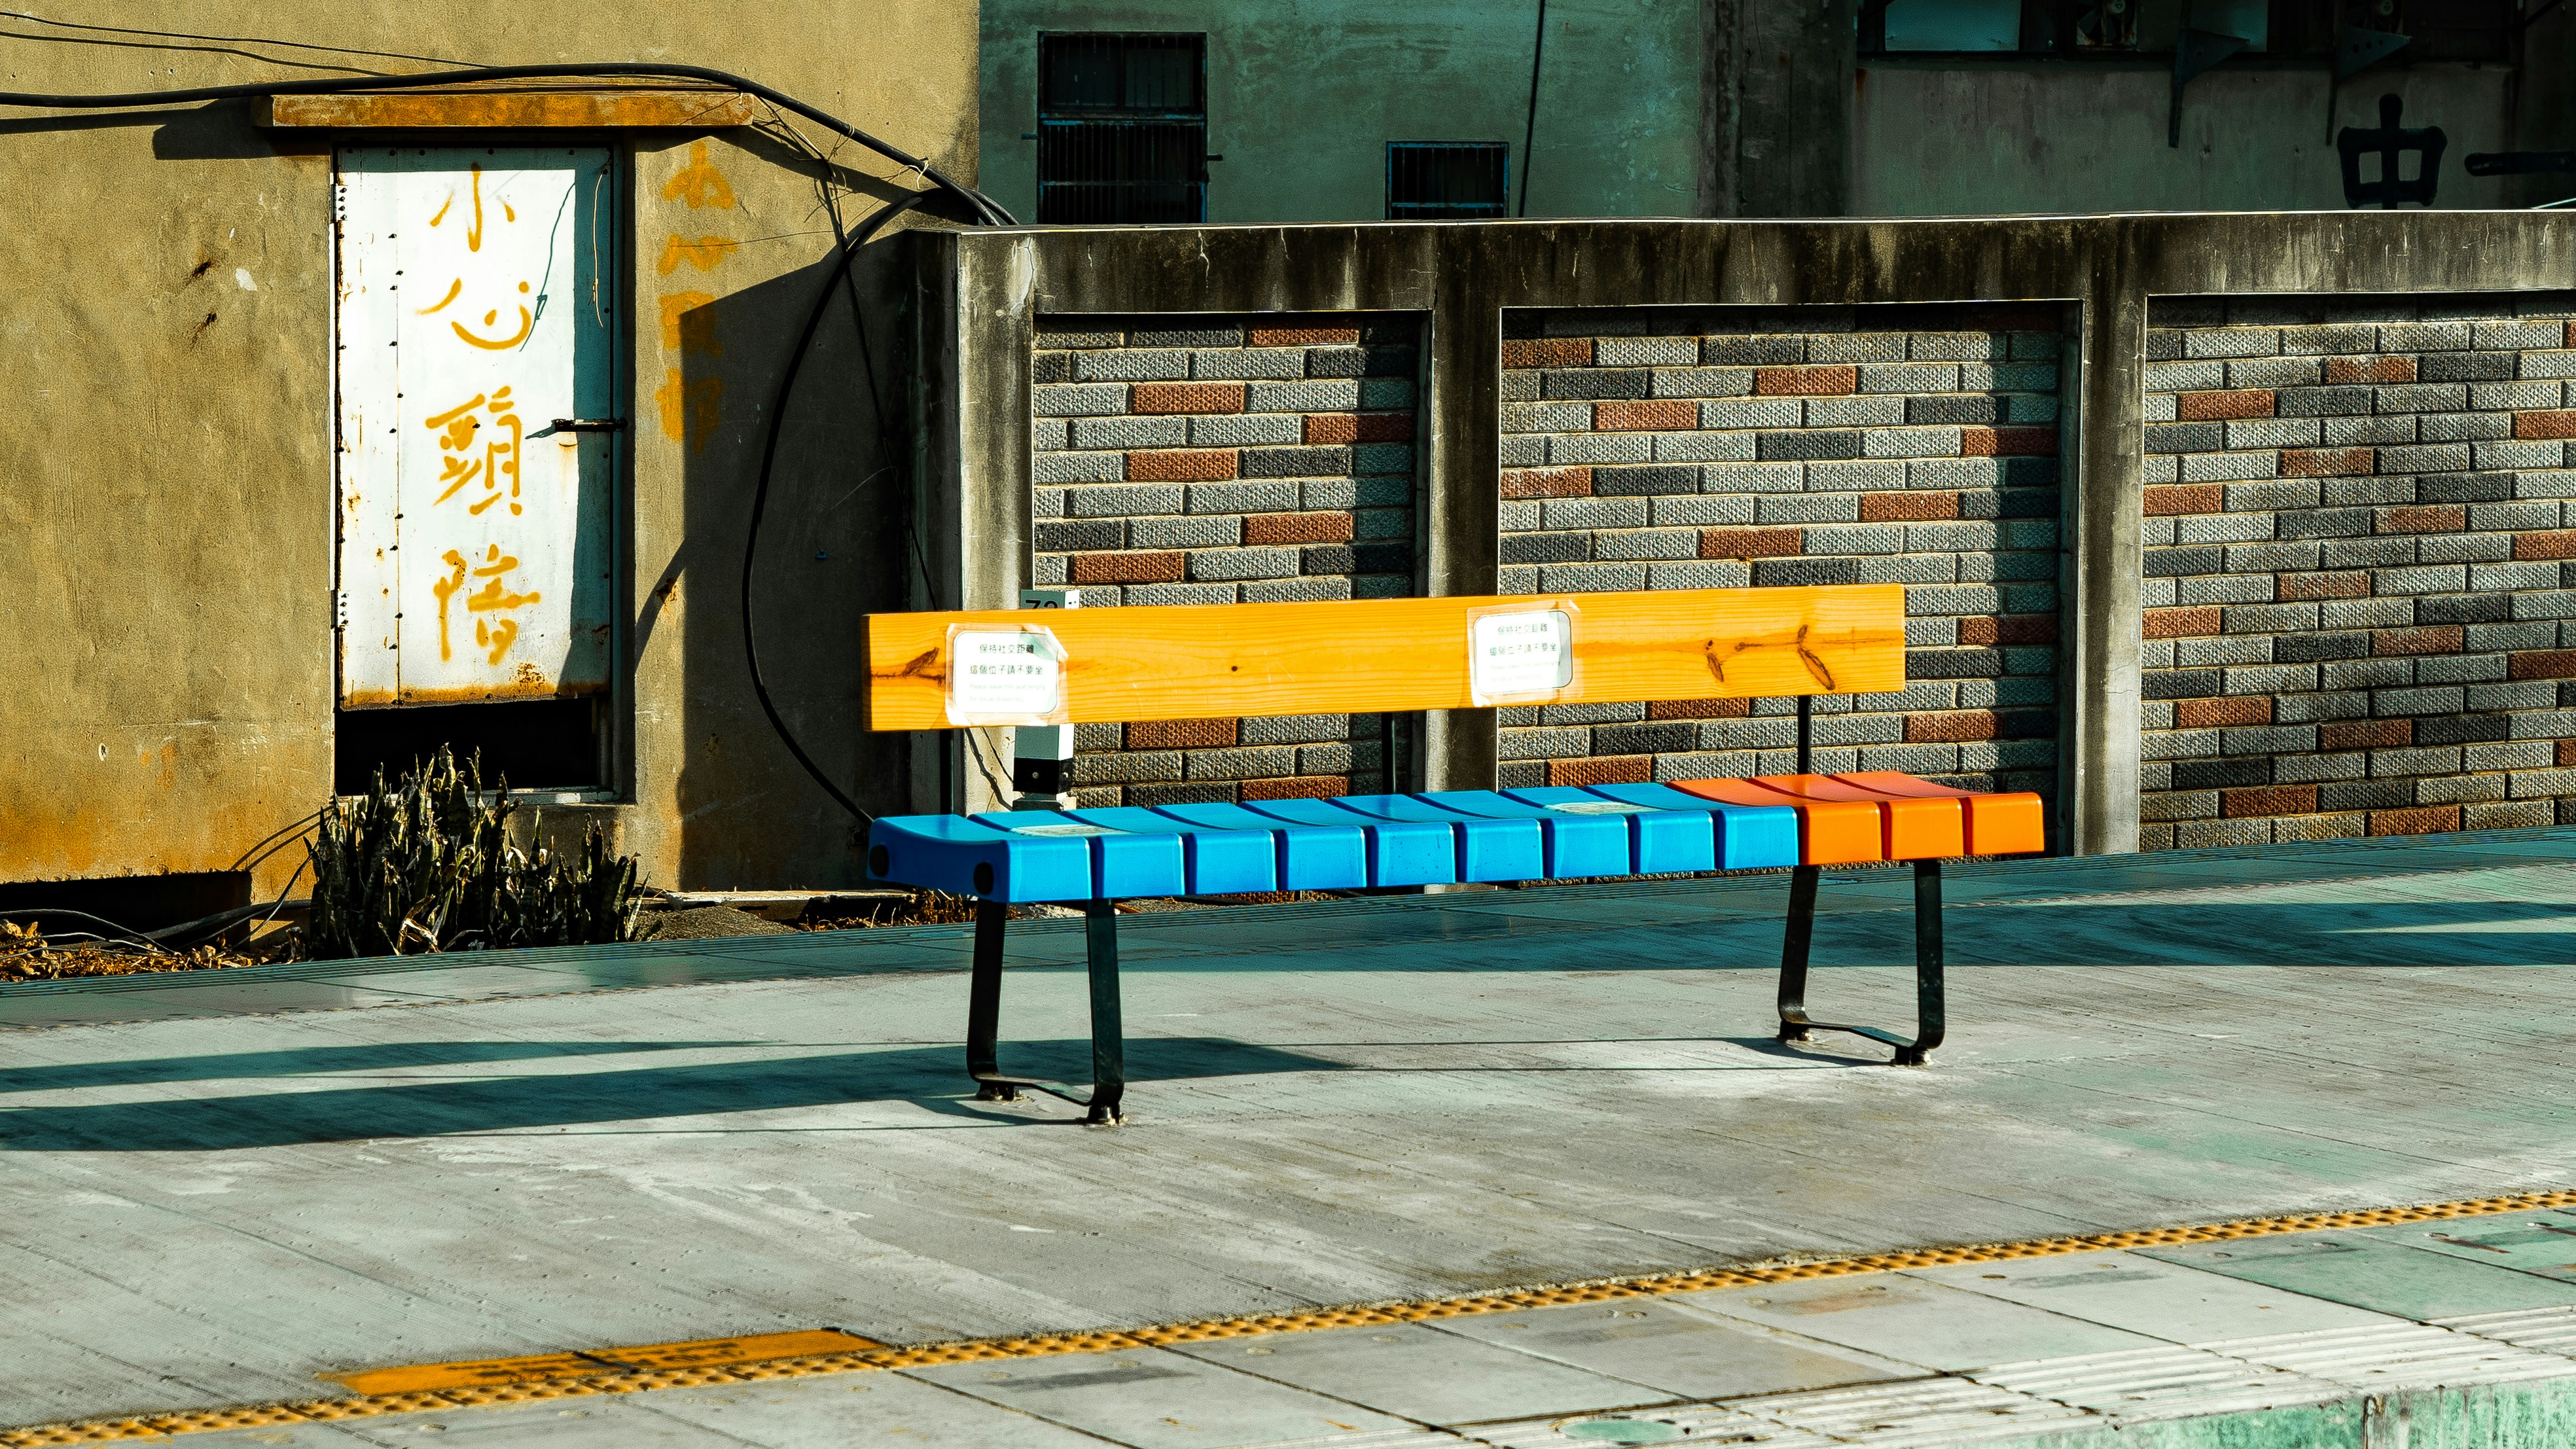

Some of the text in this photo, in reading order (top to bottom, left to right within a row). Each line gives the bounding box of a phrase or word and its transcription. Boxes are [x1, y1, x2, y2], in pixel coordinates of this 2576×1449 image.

[980, 644, 1035, 654] 保持社交距離
[970, 664, 1043, 675] 這個位子請不要坐
